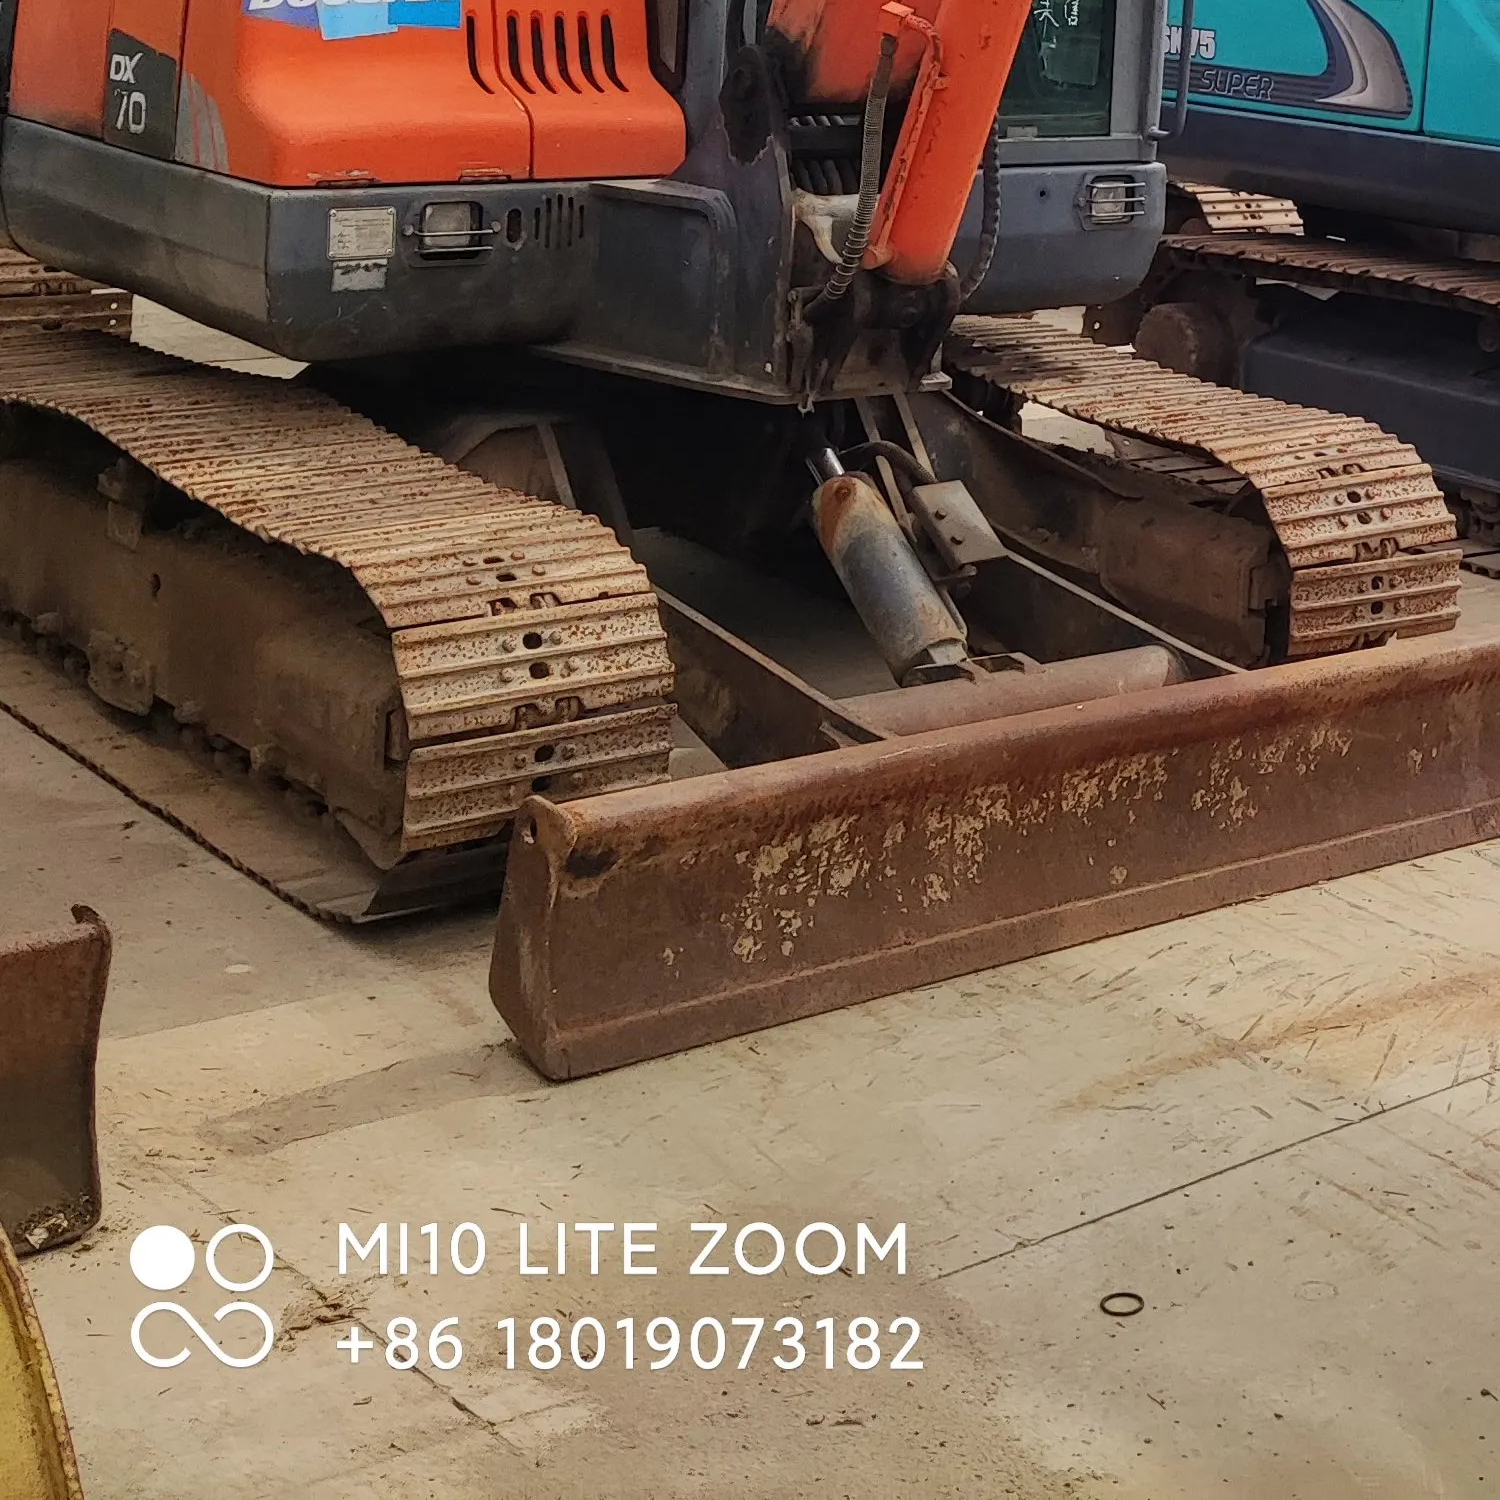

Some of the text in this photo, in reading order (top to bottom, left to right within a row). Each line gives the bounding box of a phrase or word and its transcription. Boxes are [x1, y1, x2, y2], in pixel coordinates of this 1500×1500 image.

[109, 52, 144, 84] DX
[1200, 68, 1275, 101] SUPER
[113, 88, 147, 134] 70
